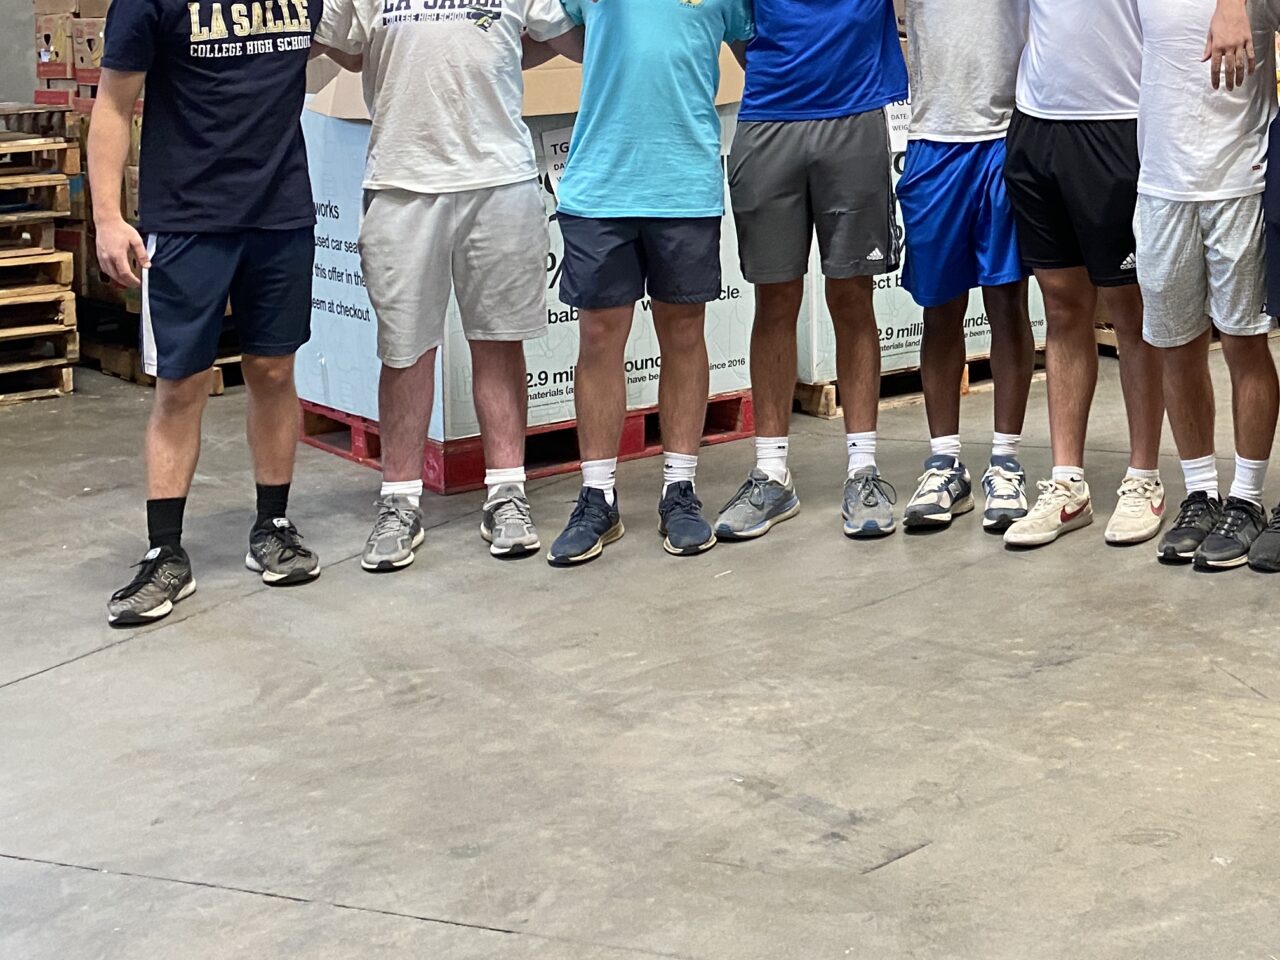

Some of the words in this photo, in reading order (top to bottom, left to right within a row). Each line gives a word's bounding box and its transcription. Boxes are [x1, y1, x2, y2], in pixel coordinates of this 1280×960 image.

[188, 2, 228, 42] LA
[190, 42, 243, 57] COLLEGE
[246, 39, 273, 55] HIGH
[331, 239, 342, 251] car
[315, 263, 326, 277] this
[327, 265, 344, 282] offer
[345, 269, 353, 284] in
[327, 300, 335, 313] at
[336, 301, 371, 322] checkout
[627, 375, 647, 384] have
[728, 358, 746, 367] 2016
